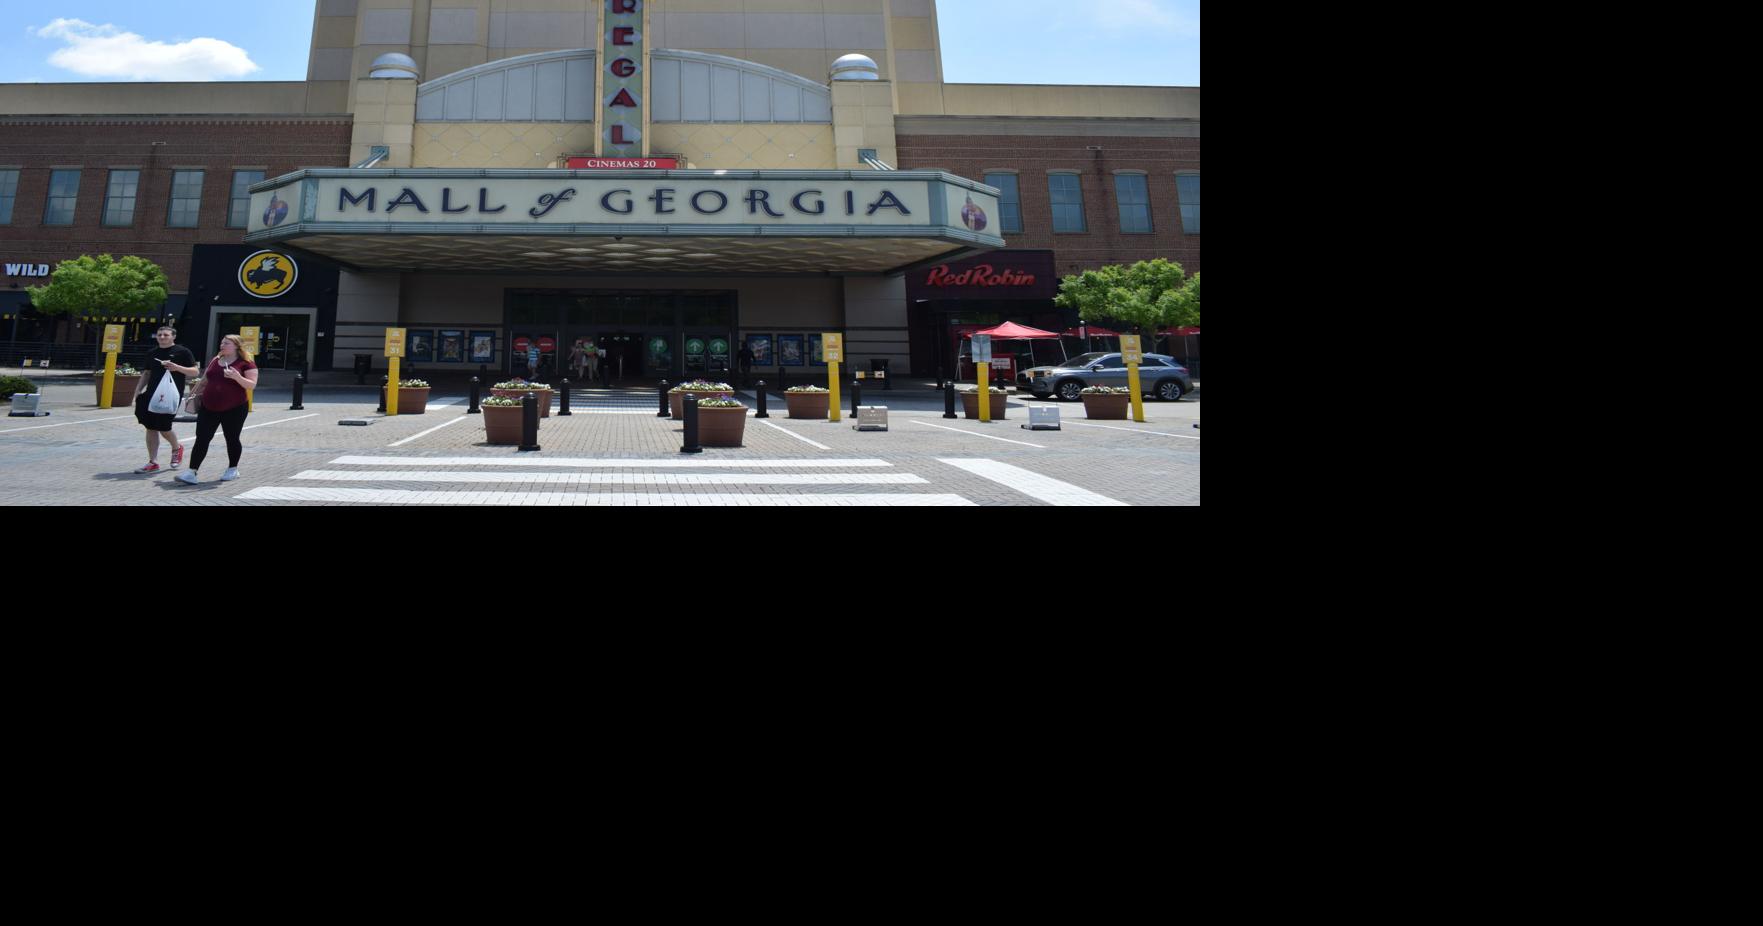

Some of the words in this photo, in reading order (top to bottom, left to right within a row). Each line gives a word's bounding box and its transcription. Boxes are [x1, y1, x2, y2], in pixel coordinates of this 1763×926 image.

[609, 0, 637, 144] REGAL
[587, 159, 640, 169] CINEMAS
[643, 160, 657, 169] 20
[338, 186, 507, 214] MALL
[528, 188, 577, 217] of
[599, 188, 911, 218] GEORGIA
[5, 263, 50, 277] WILD
